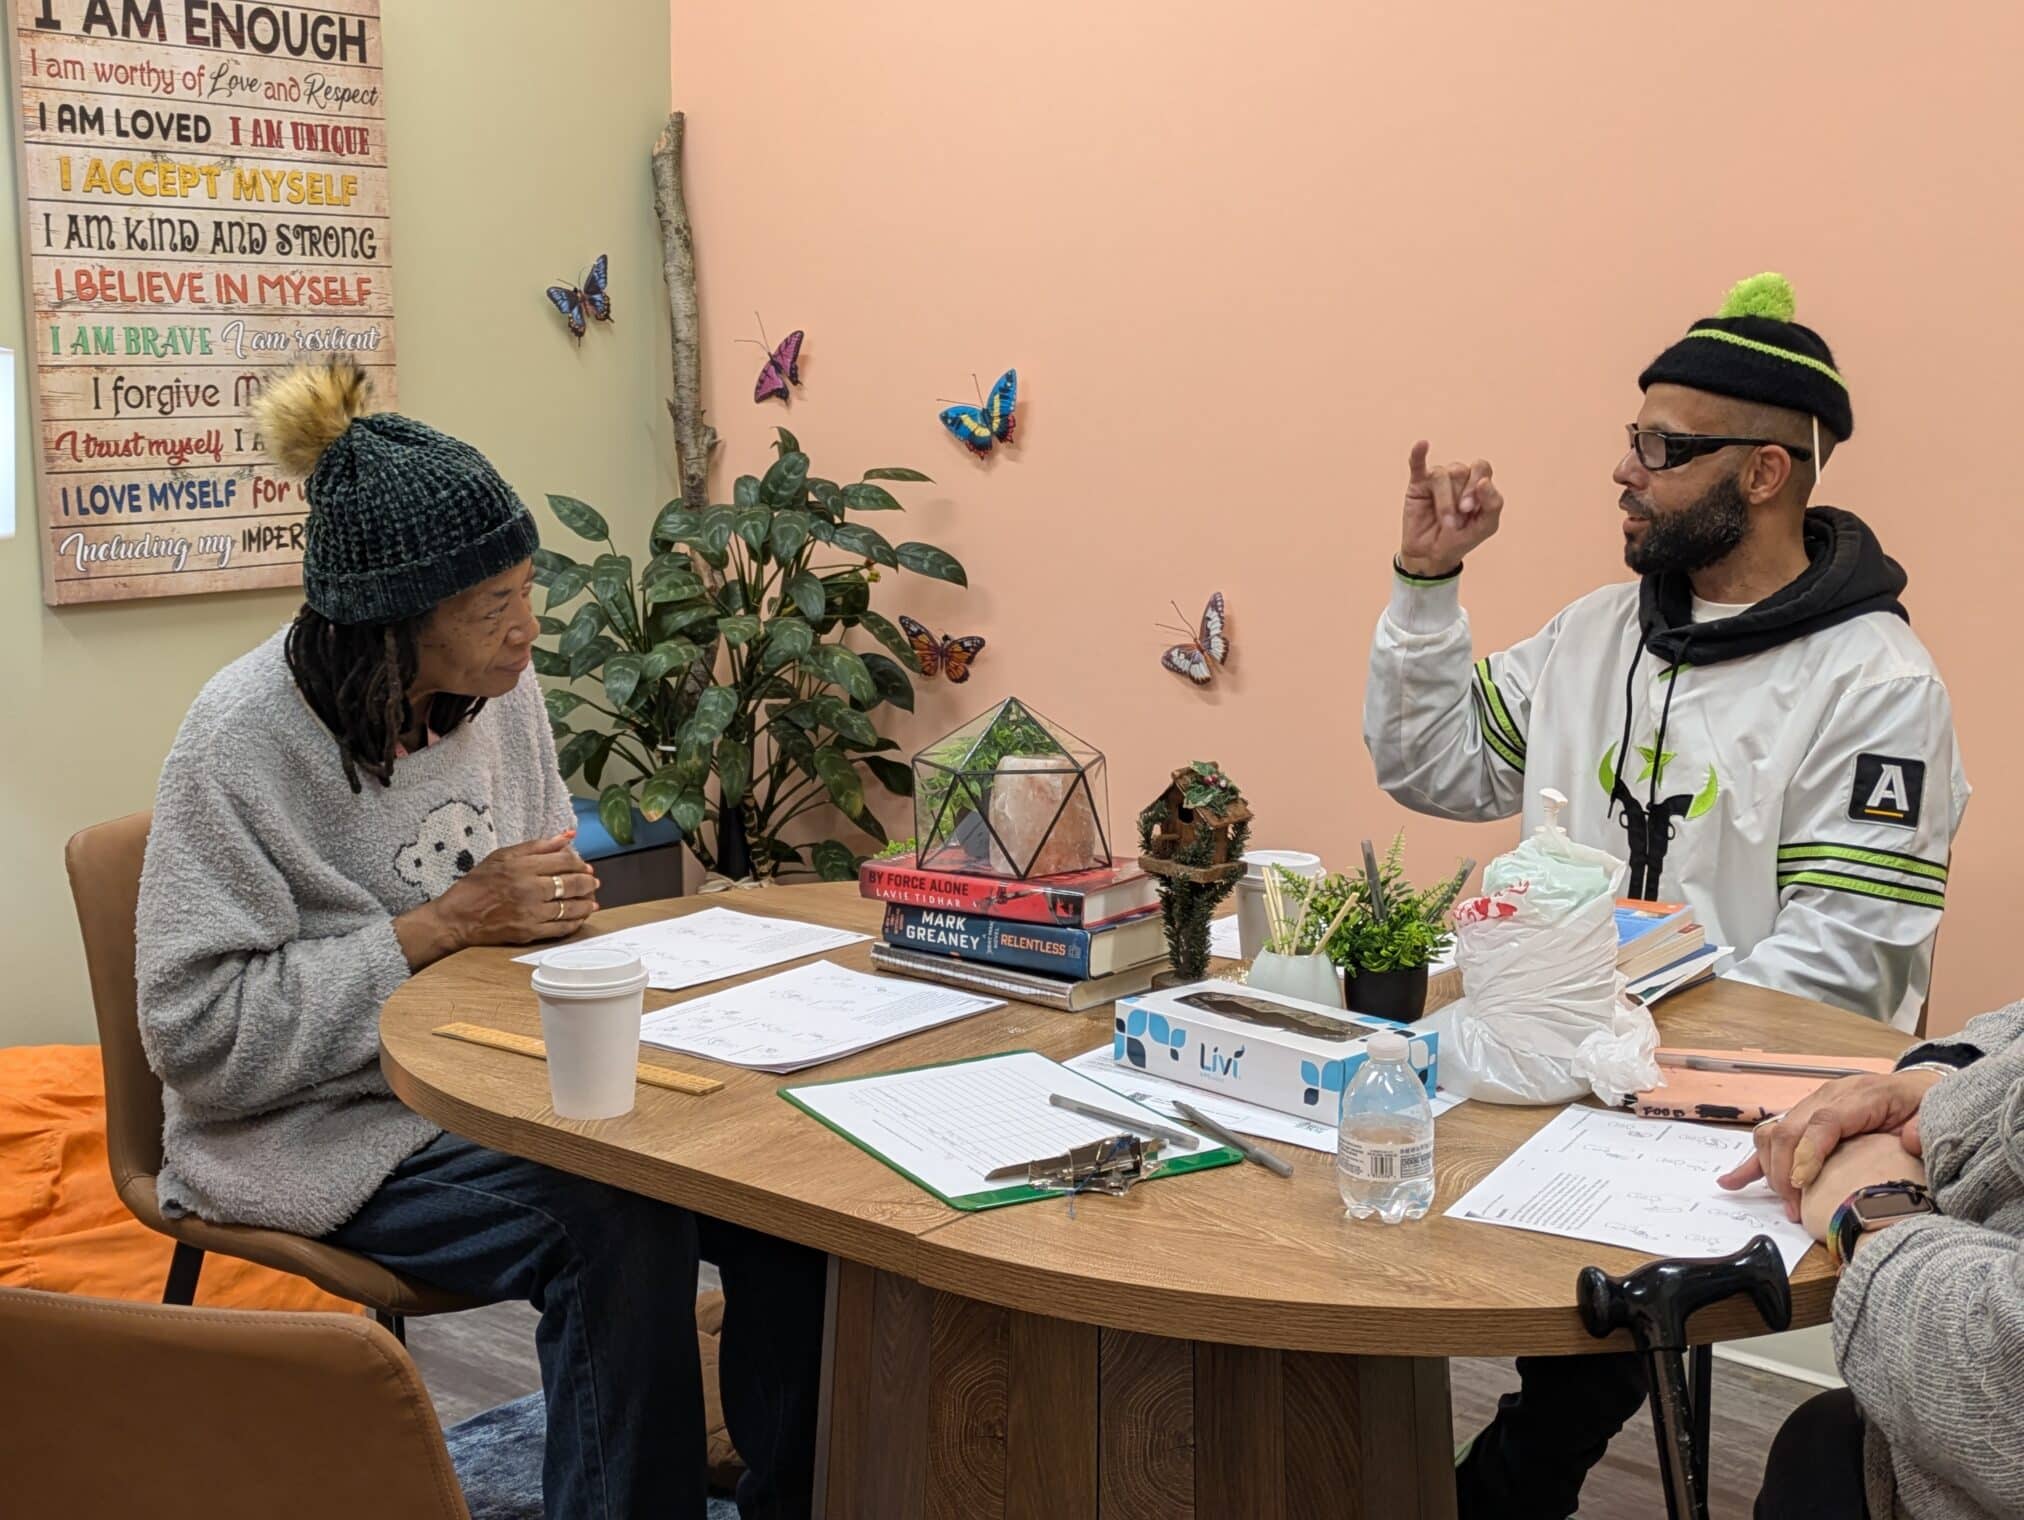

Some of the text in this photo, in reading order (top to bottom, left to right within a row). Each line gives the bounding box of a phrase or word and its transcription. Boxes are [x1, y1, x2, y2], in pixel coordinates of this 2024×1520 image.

[35, 0, 368, 64] I AM ENOUGH
[30, 48, 380, 111] I am worthy of Love and Respect
[39, 102, 371, 156] I AM LOVED I AM UNIQUE
[59, 156, 359, 207] I ACCEPT MYSELF
[43, 212, 378, 260] I AM KIND AND STRONG
[55, 268, 373, 307] I BELIEVE IN MYSELF
[50, 320, 382, 360] I AM BRAVE I am resilient
[92, 377, 101, 411] I
[112, 375, 220, 417] forgive
[54, 429, 83, 464] I
[84, 431, 146, 459] trust
[147, 429, 224, 465] myself
[234, 428, 244, 453] I
[62, 487, 70, 517] I
[76, 482, 143, 515] LOVE
[148, 478, 237, 511] MYSELF
[59, 522, 305, 573] Including my IMPER
[1865, 763, 1911, 812] A
[868, 870, 969, 897] BY FORCE ALONE
[876, 888, 961, 908] LAVIE TIDHAR
[906, 925, 980, 951] GREANEY
[921, 910, 968, 932] MARK
[1000, 933, 1067, 957] RELENTLESS
[1200, 1042, 1246, 1079] Livi
